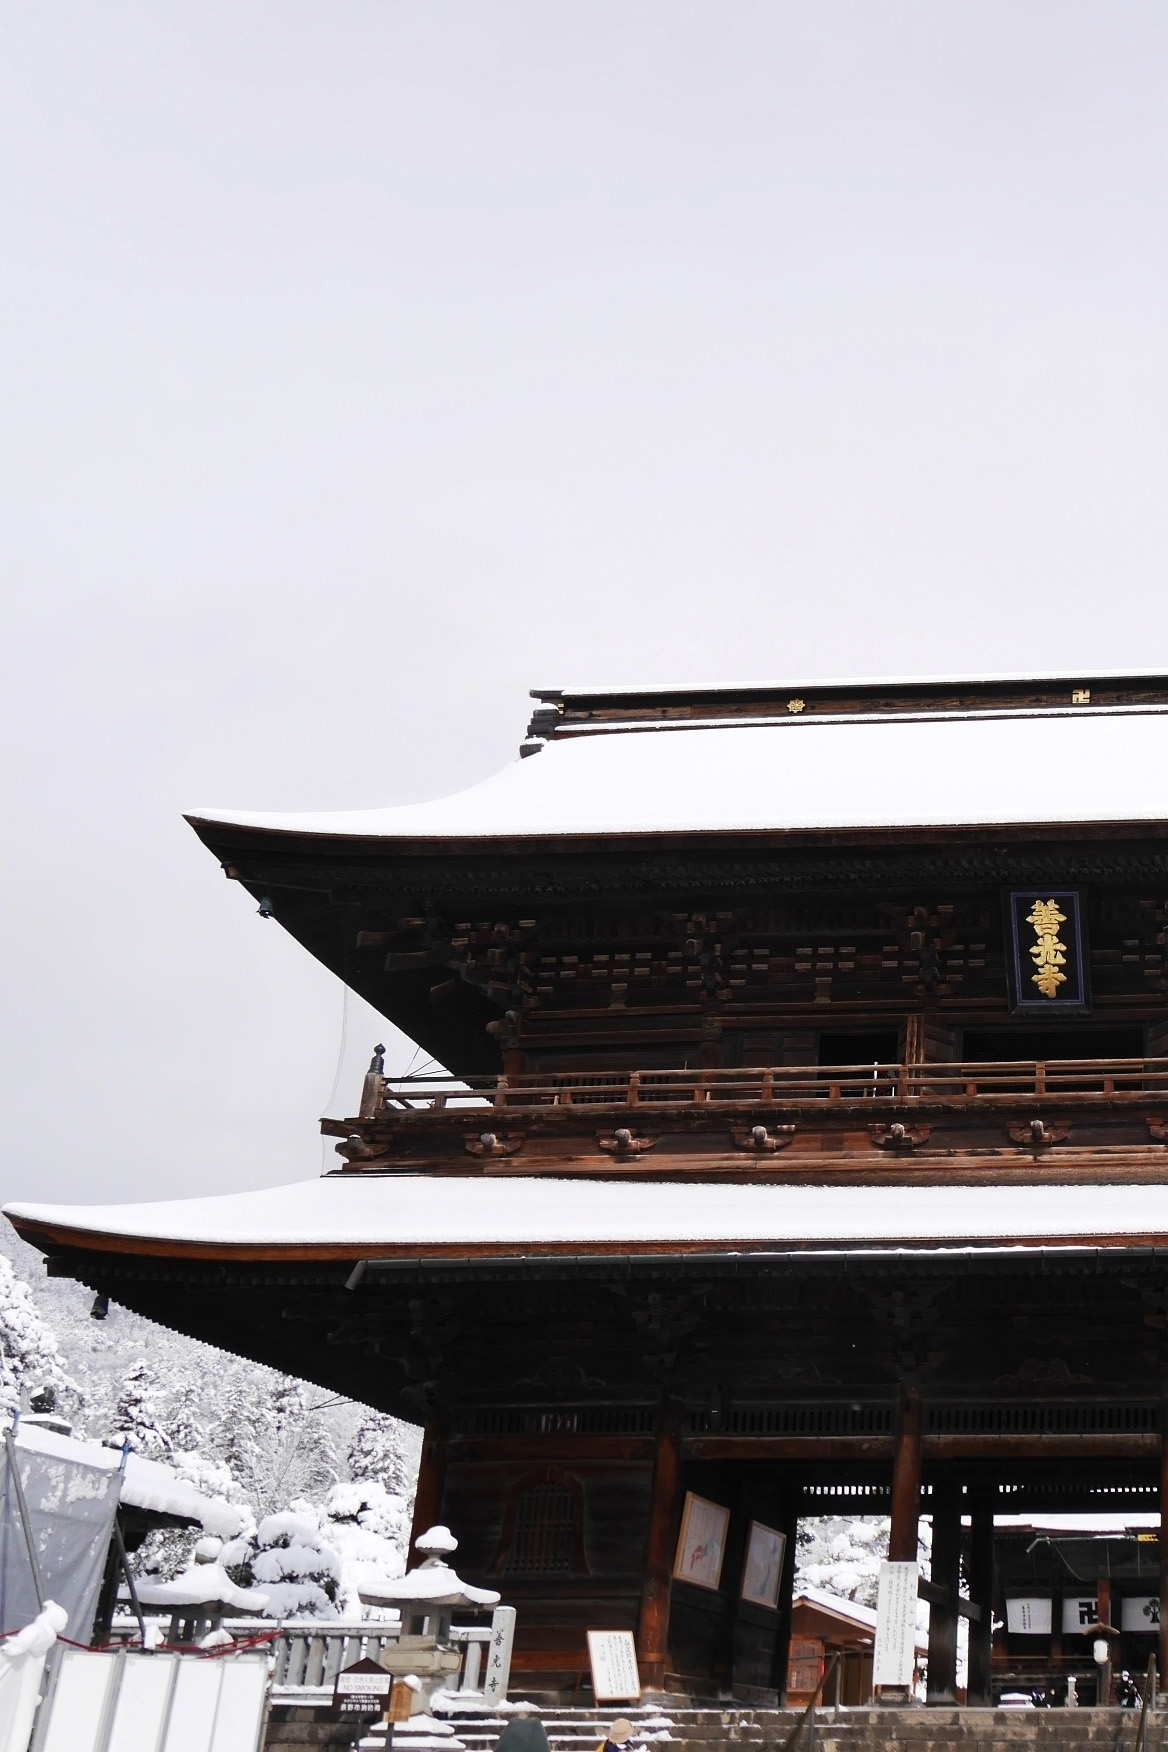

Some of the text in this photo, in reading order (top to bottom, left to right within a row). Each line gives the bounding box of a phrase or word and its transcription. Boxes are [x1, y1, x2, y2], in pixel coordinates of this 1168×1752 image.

[1026, 899, 1067, 998] 善光寺
[488, 1629, 505, 1693] 善光寺
